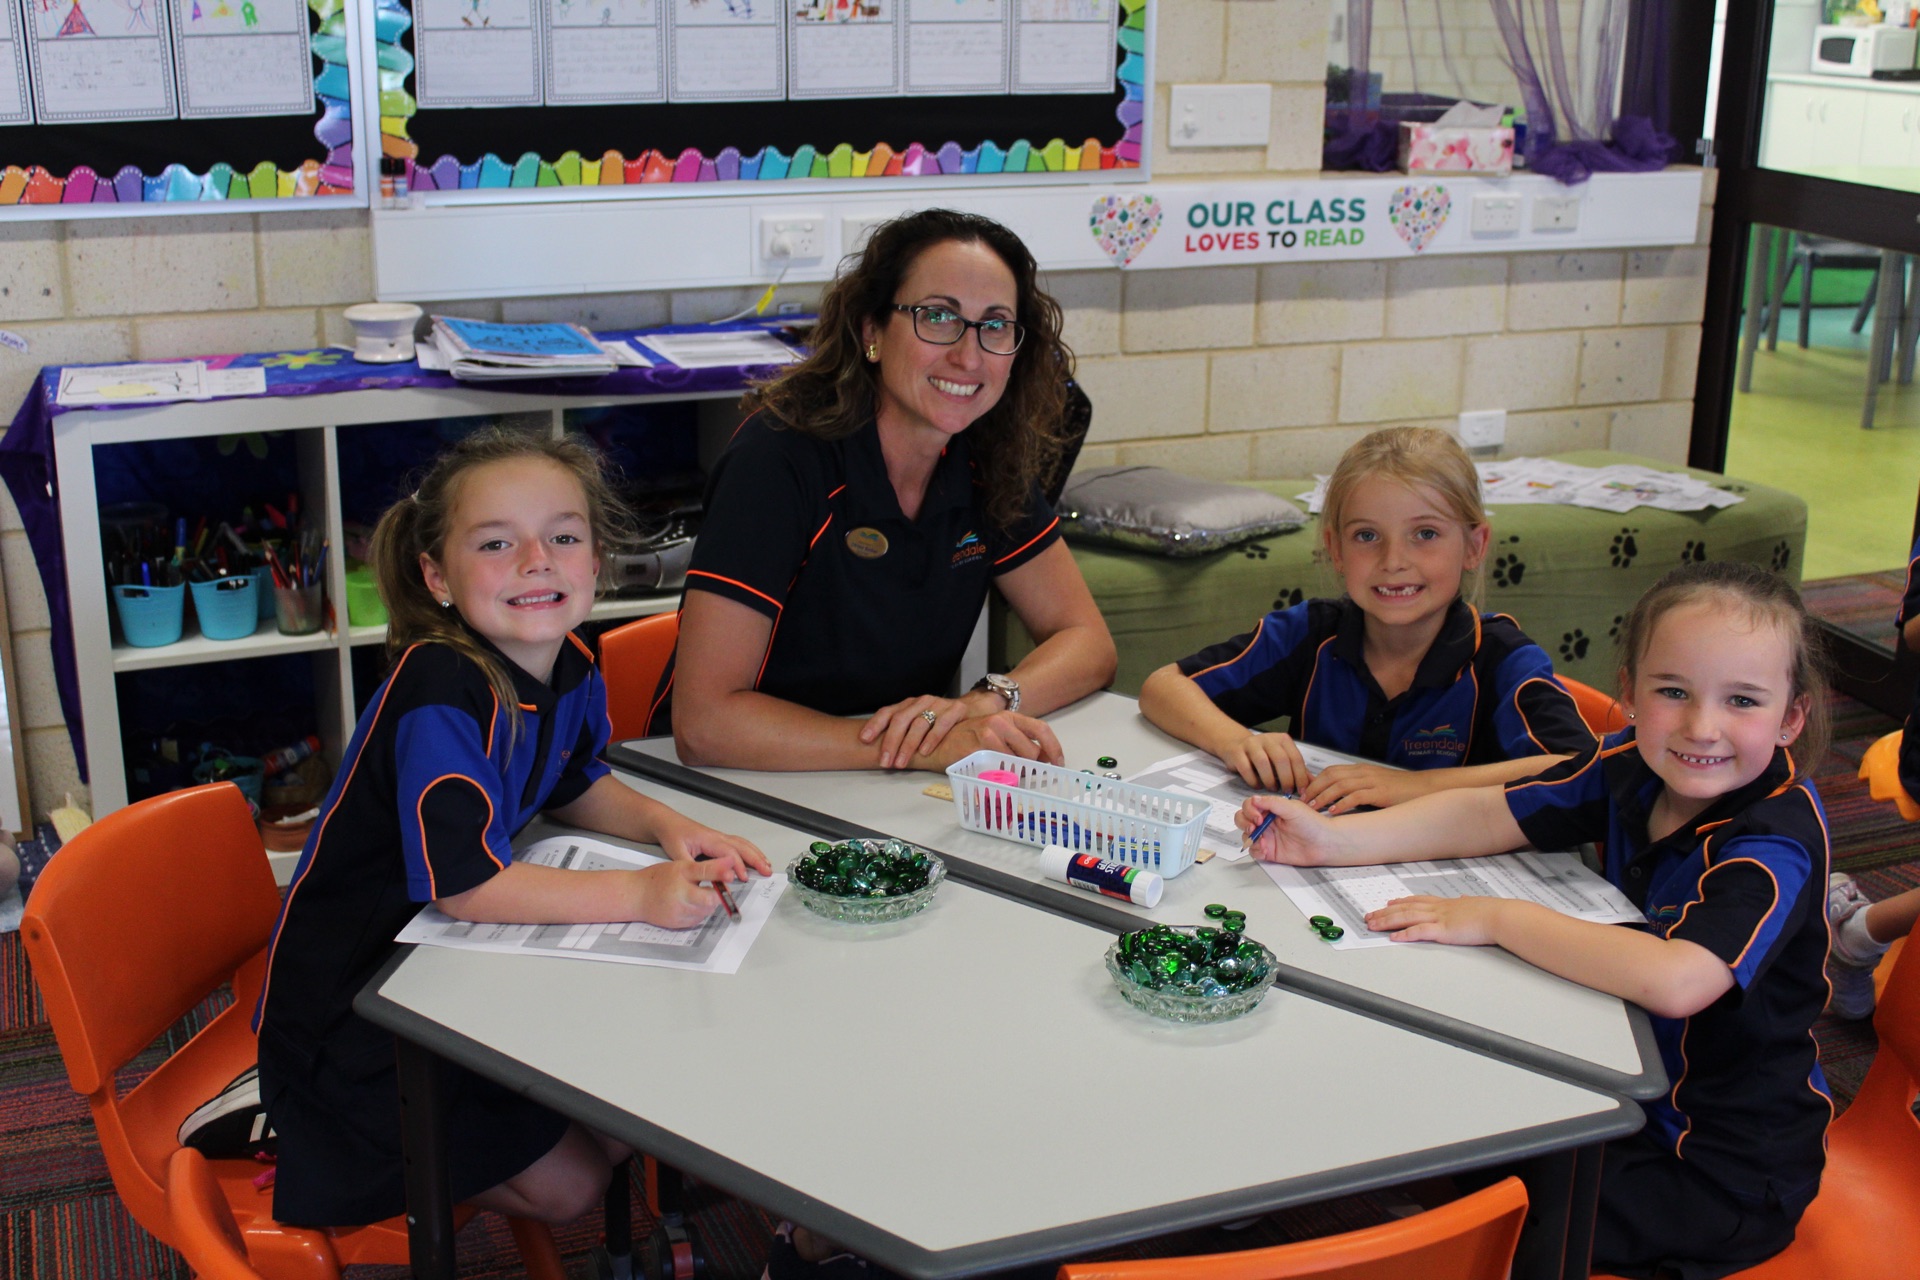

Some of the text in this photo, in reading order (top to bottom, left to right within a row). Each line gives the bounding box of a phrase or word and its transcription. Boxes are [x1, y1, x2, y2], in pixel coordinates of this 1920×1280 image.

[1187, 198, 1366, 229] OUR CLASS
[1185, 228, 1365, 253] LOVES TO READ
[1402, 738, 1465, 752] Treendale
